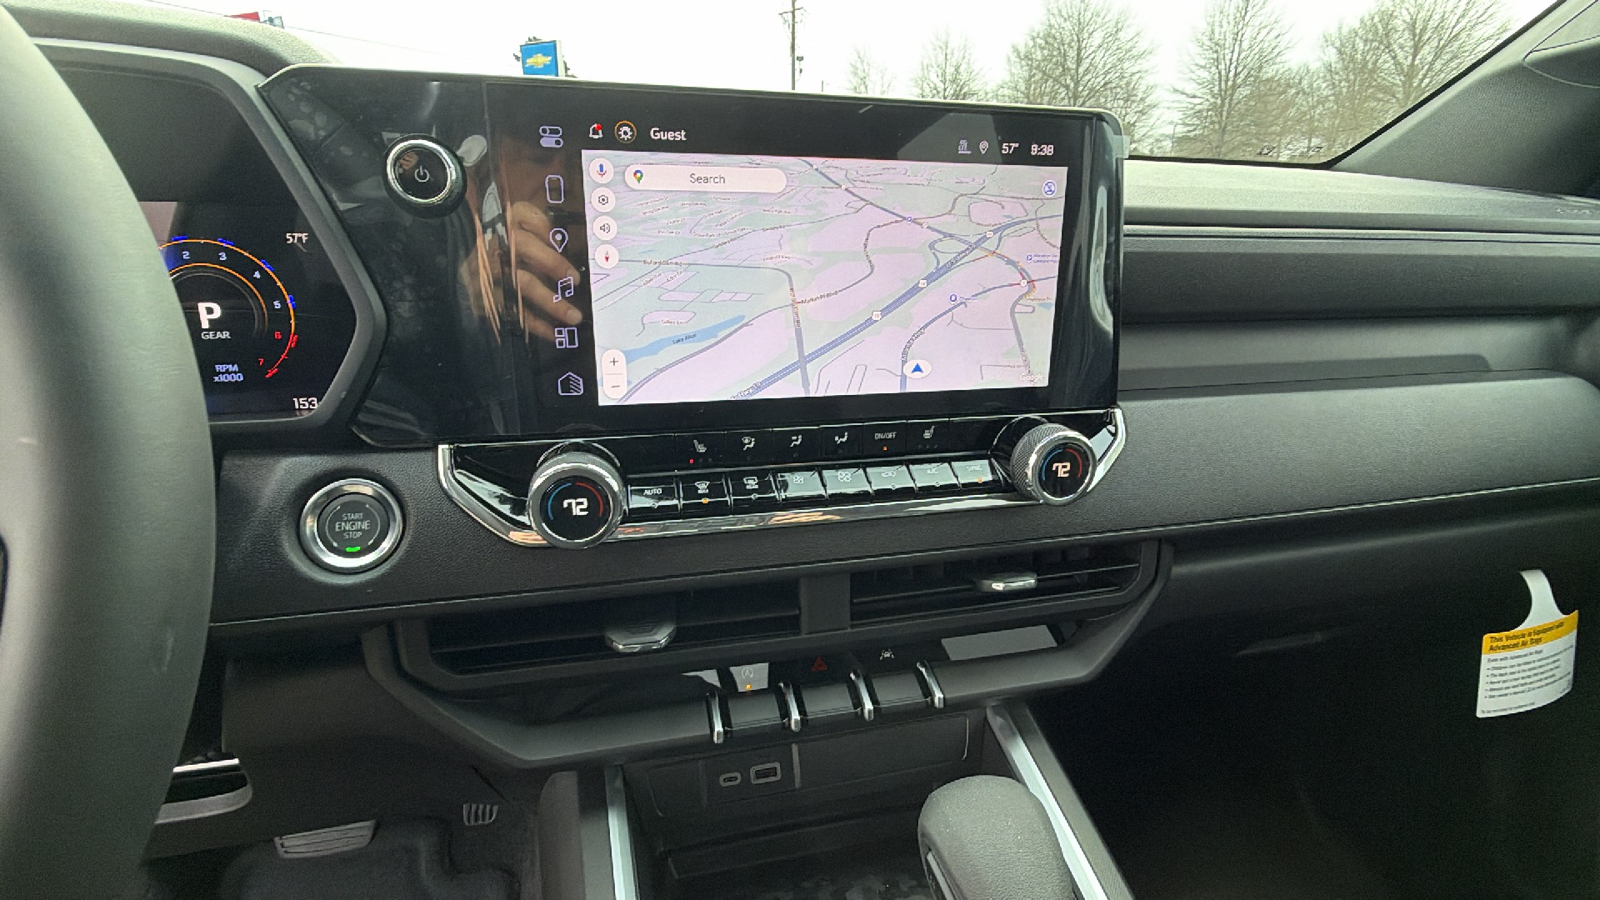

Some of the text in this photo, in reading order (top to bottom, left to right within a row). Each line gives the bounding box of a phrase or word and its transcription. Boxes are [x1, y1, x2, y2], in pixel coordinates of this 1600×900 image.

[649, 127, 687, 141] Guest
[689, 173, 726, 184] Search
[182, 251, 190, 260] 2
[218, 252, 227, 261] 3
[253, 270, 261, 279] 4
[273, 300, 281, 309] 5
[197, 302, 222, 329] P
[201, 331, 231, 340] GEAR
[274, 331, 282, 340] 6
[258, 358, 264, 366] 7
[215, 364, 239, 372] RPM
[213, 373, 244, 382] x1000
[293, 397, 319, 409] 153
[874, 431, 897, 440] ON/OFF
[1052, 462, 1071, 478] 72
[643, 487, 663, 495] AUTO
[563, 497, 589, 517] 72
[335, 520, 371, 532] ENGINE
[343, 531, 363, 539] STOP
[1489, 635, 1504, 643] This
[1505, 633, 1526, 641] Vehicle
[1488, 641, 1520, 652] Advanced
